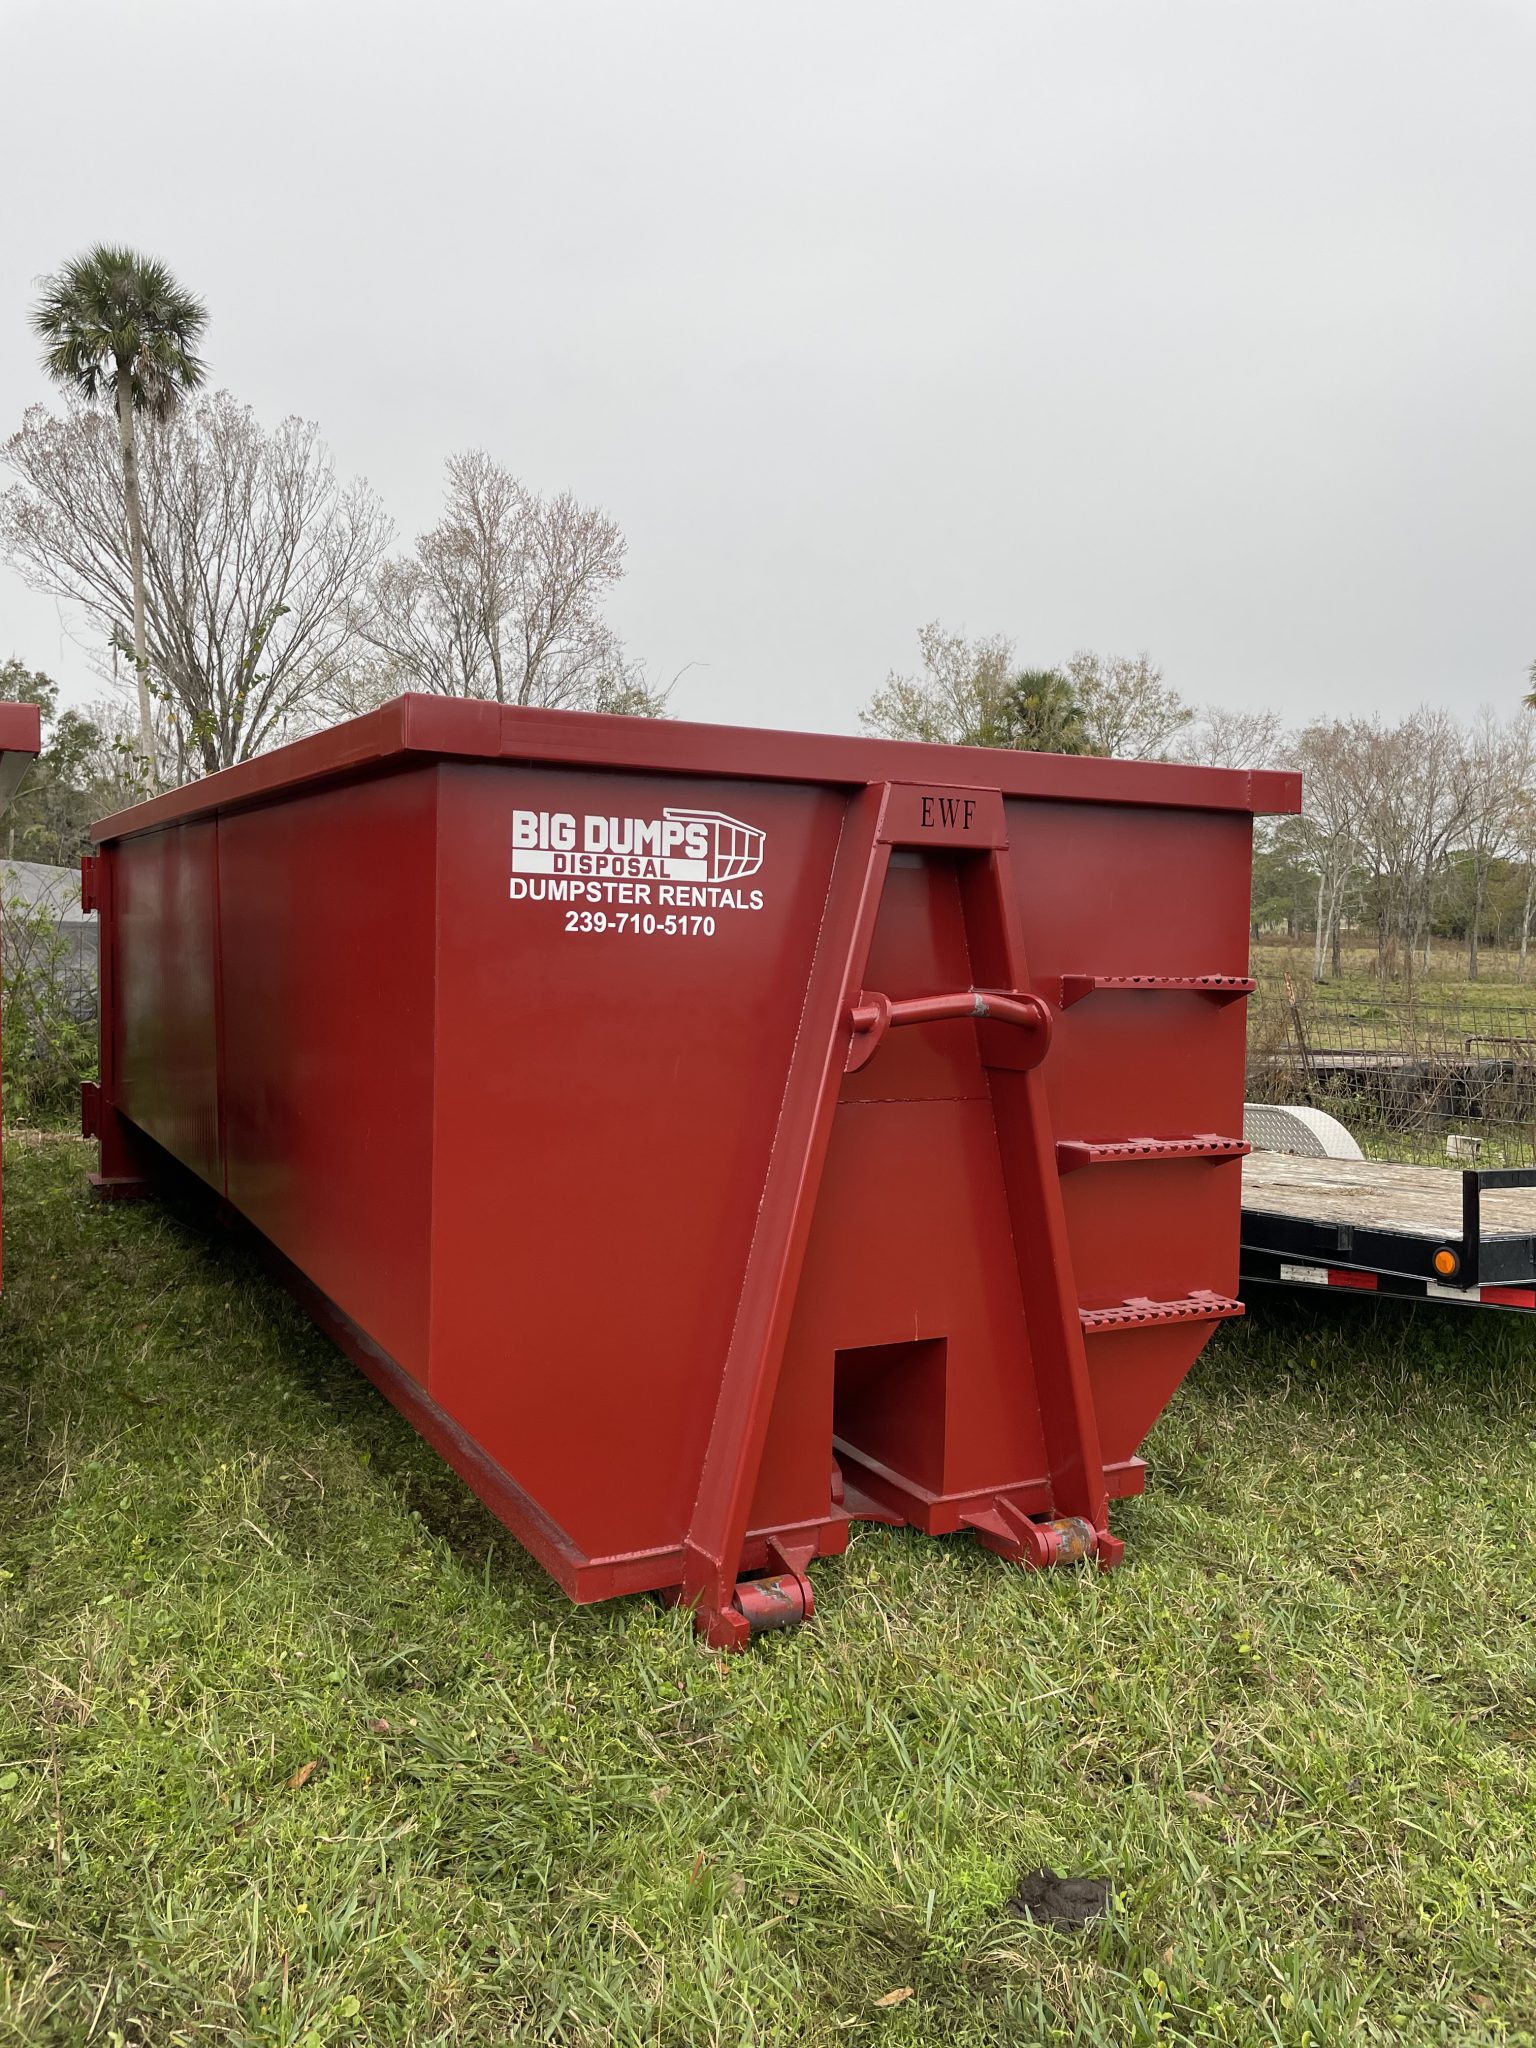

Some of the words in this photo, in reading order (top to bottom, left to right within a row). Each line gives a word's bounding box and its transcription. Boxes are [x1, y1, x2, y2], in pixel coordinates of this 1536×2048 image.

[921, 796, 976, 830] EWF
[512, 810, 576, 851] BIG
[584, 815, 708, 859] DUMPS
[553, 853, 671, 878] DISPOSAL
[509, 878, 652, 905] DUMPSTER
[659, 885, 764, 910] RENTALS
[565, 910, 716, 937] 239-710-5170
